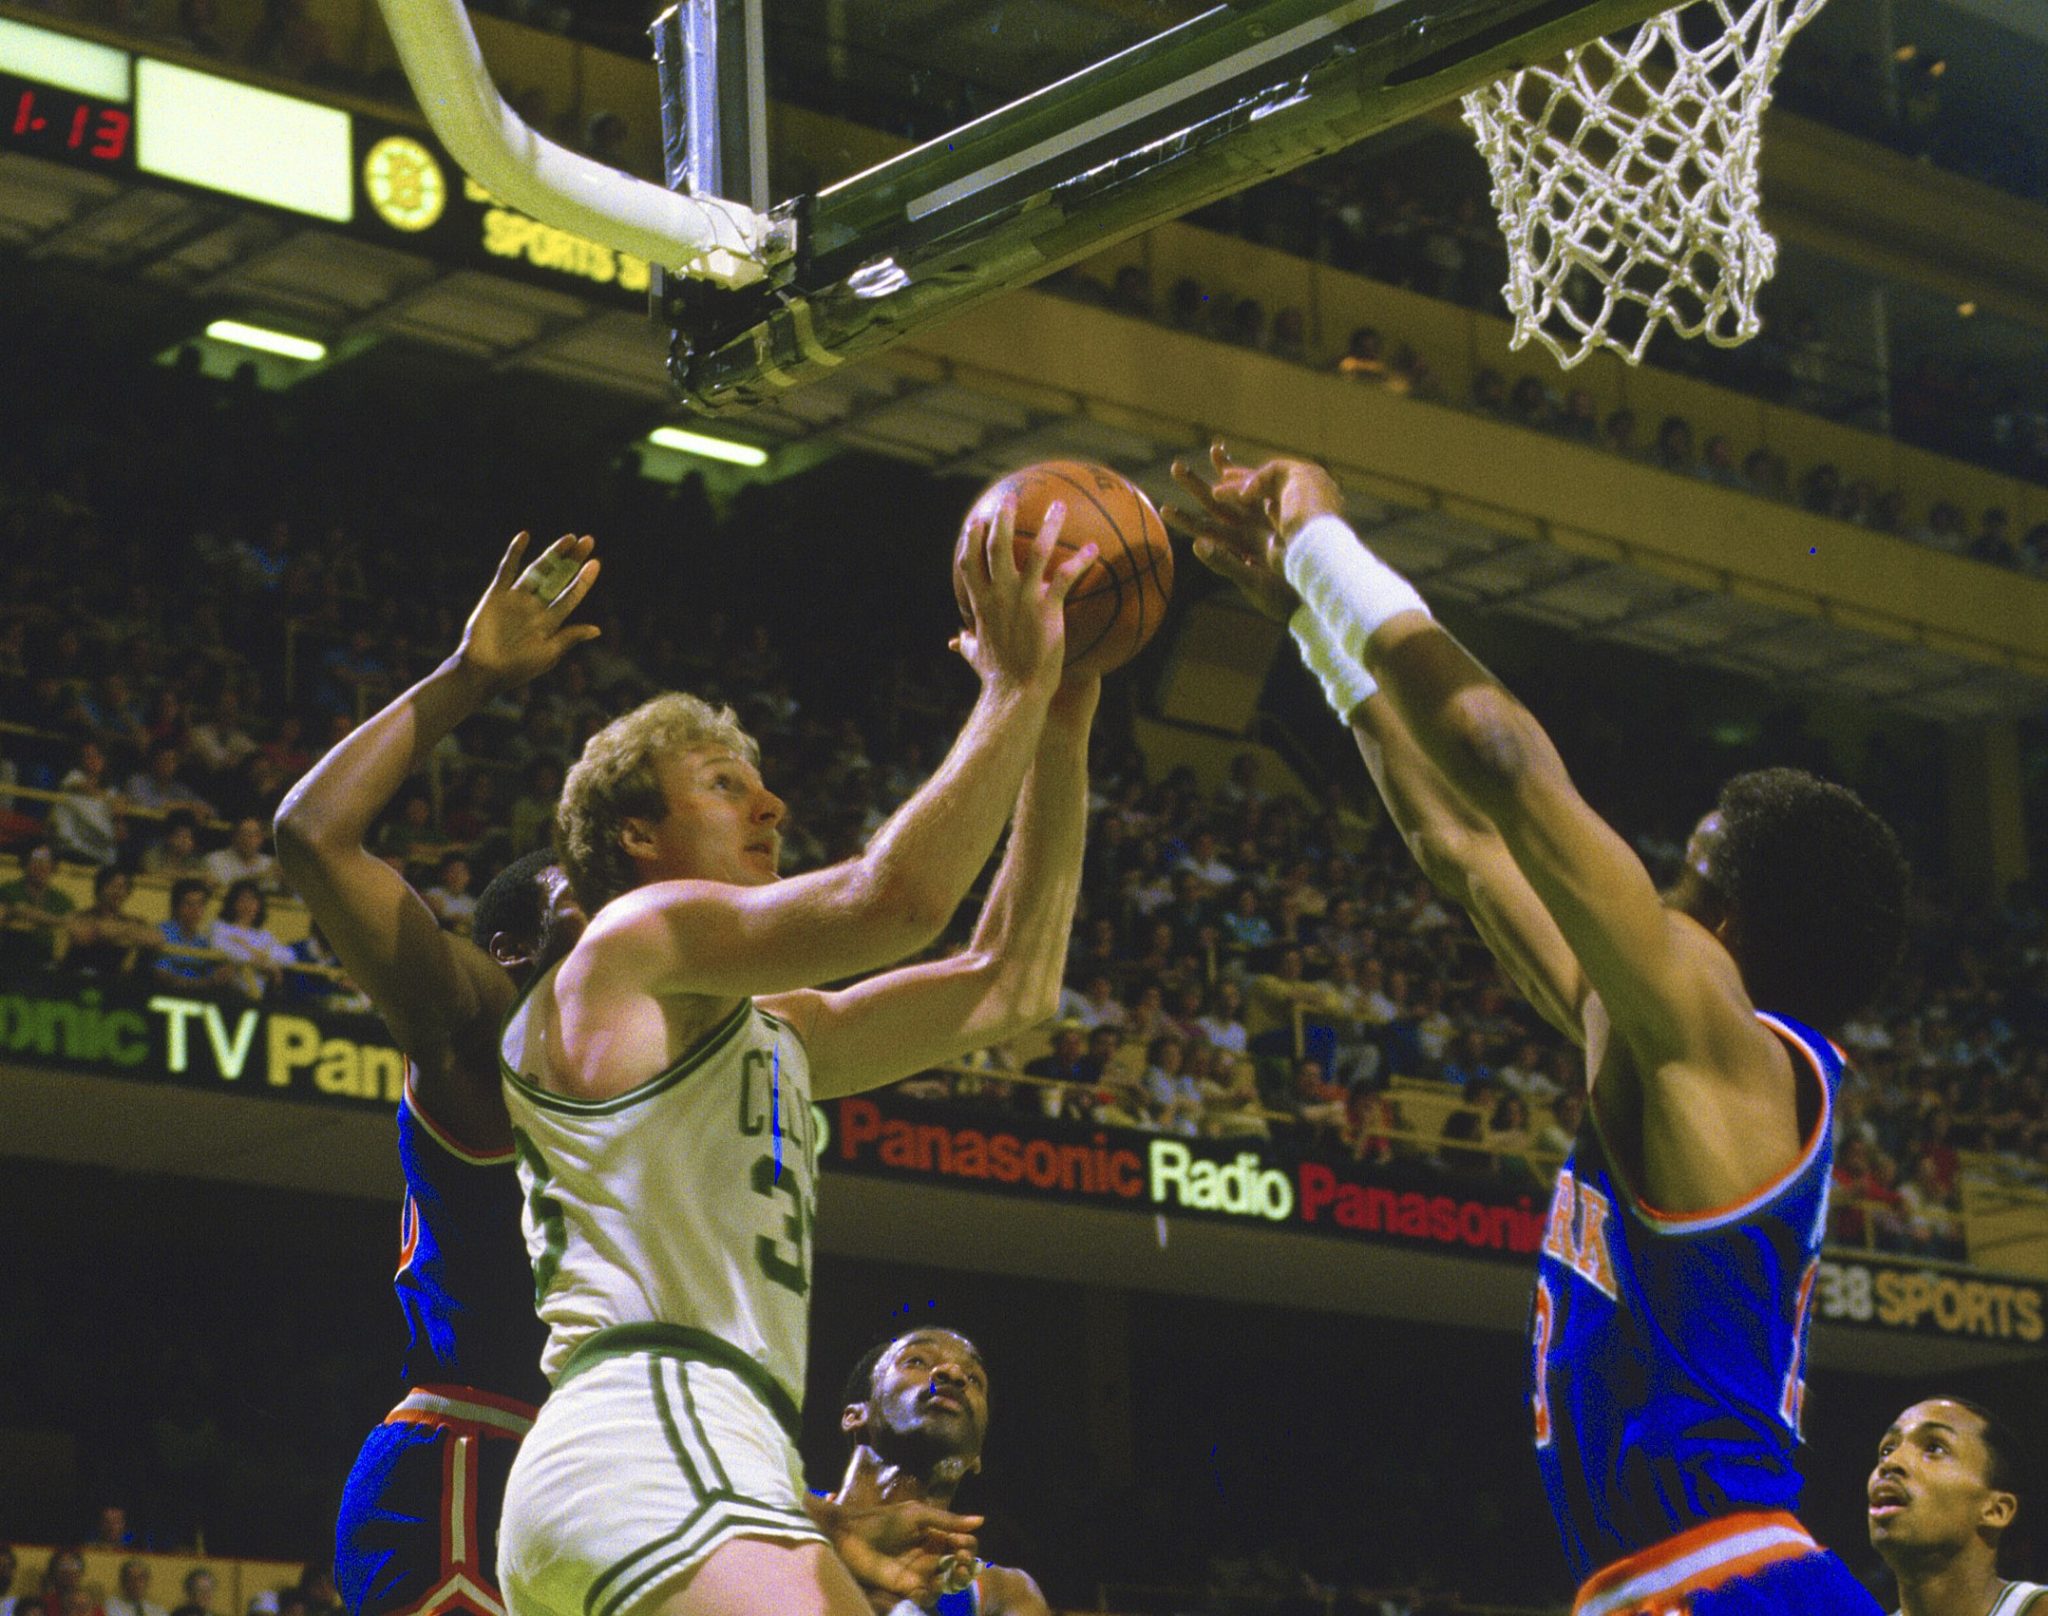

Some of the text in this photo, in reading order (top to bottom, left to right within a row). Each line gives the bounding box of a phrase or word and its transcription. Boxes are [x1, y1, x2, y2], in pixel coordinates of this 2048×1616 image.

[148, 995, 259, 1080] TV
[839, 1099, 1143, 1197] Panasonic
[1149, 1139, 1294, 1222] Radio
[1818, 1262, 2045, 1342] 38 SPORTS
